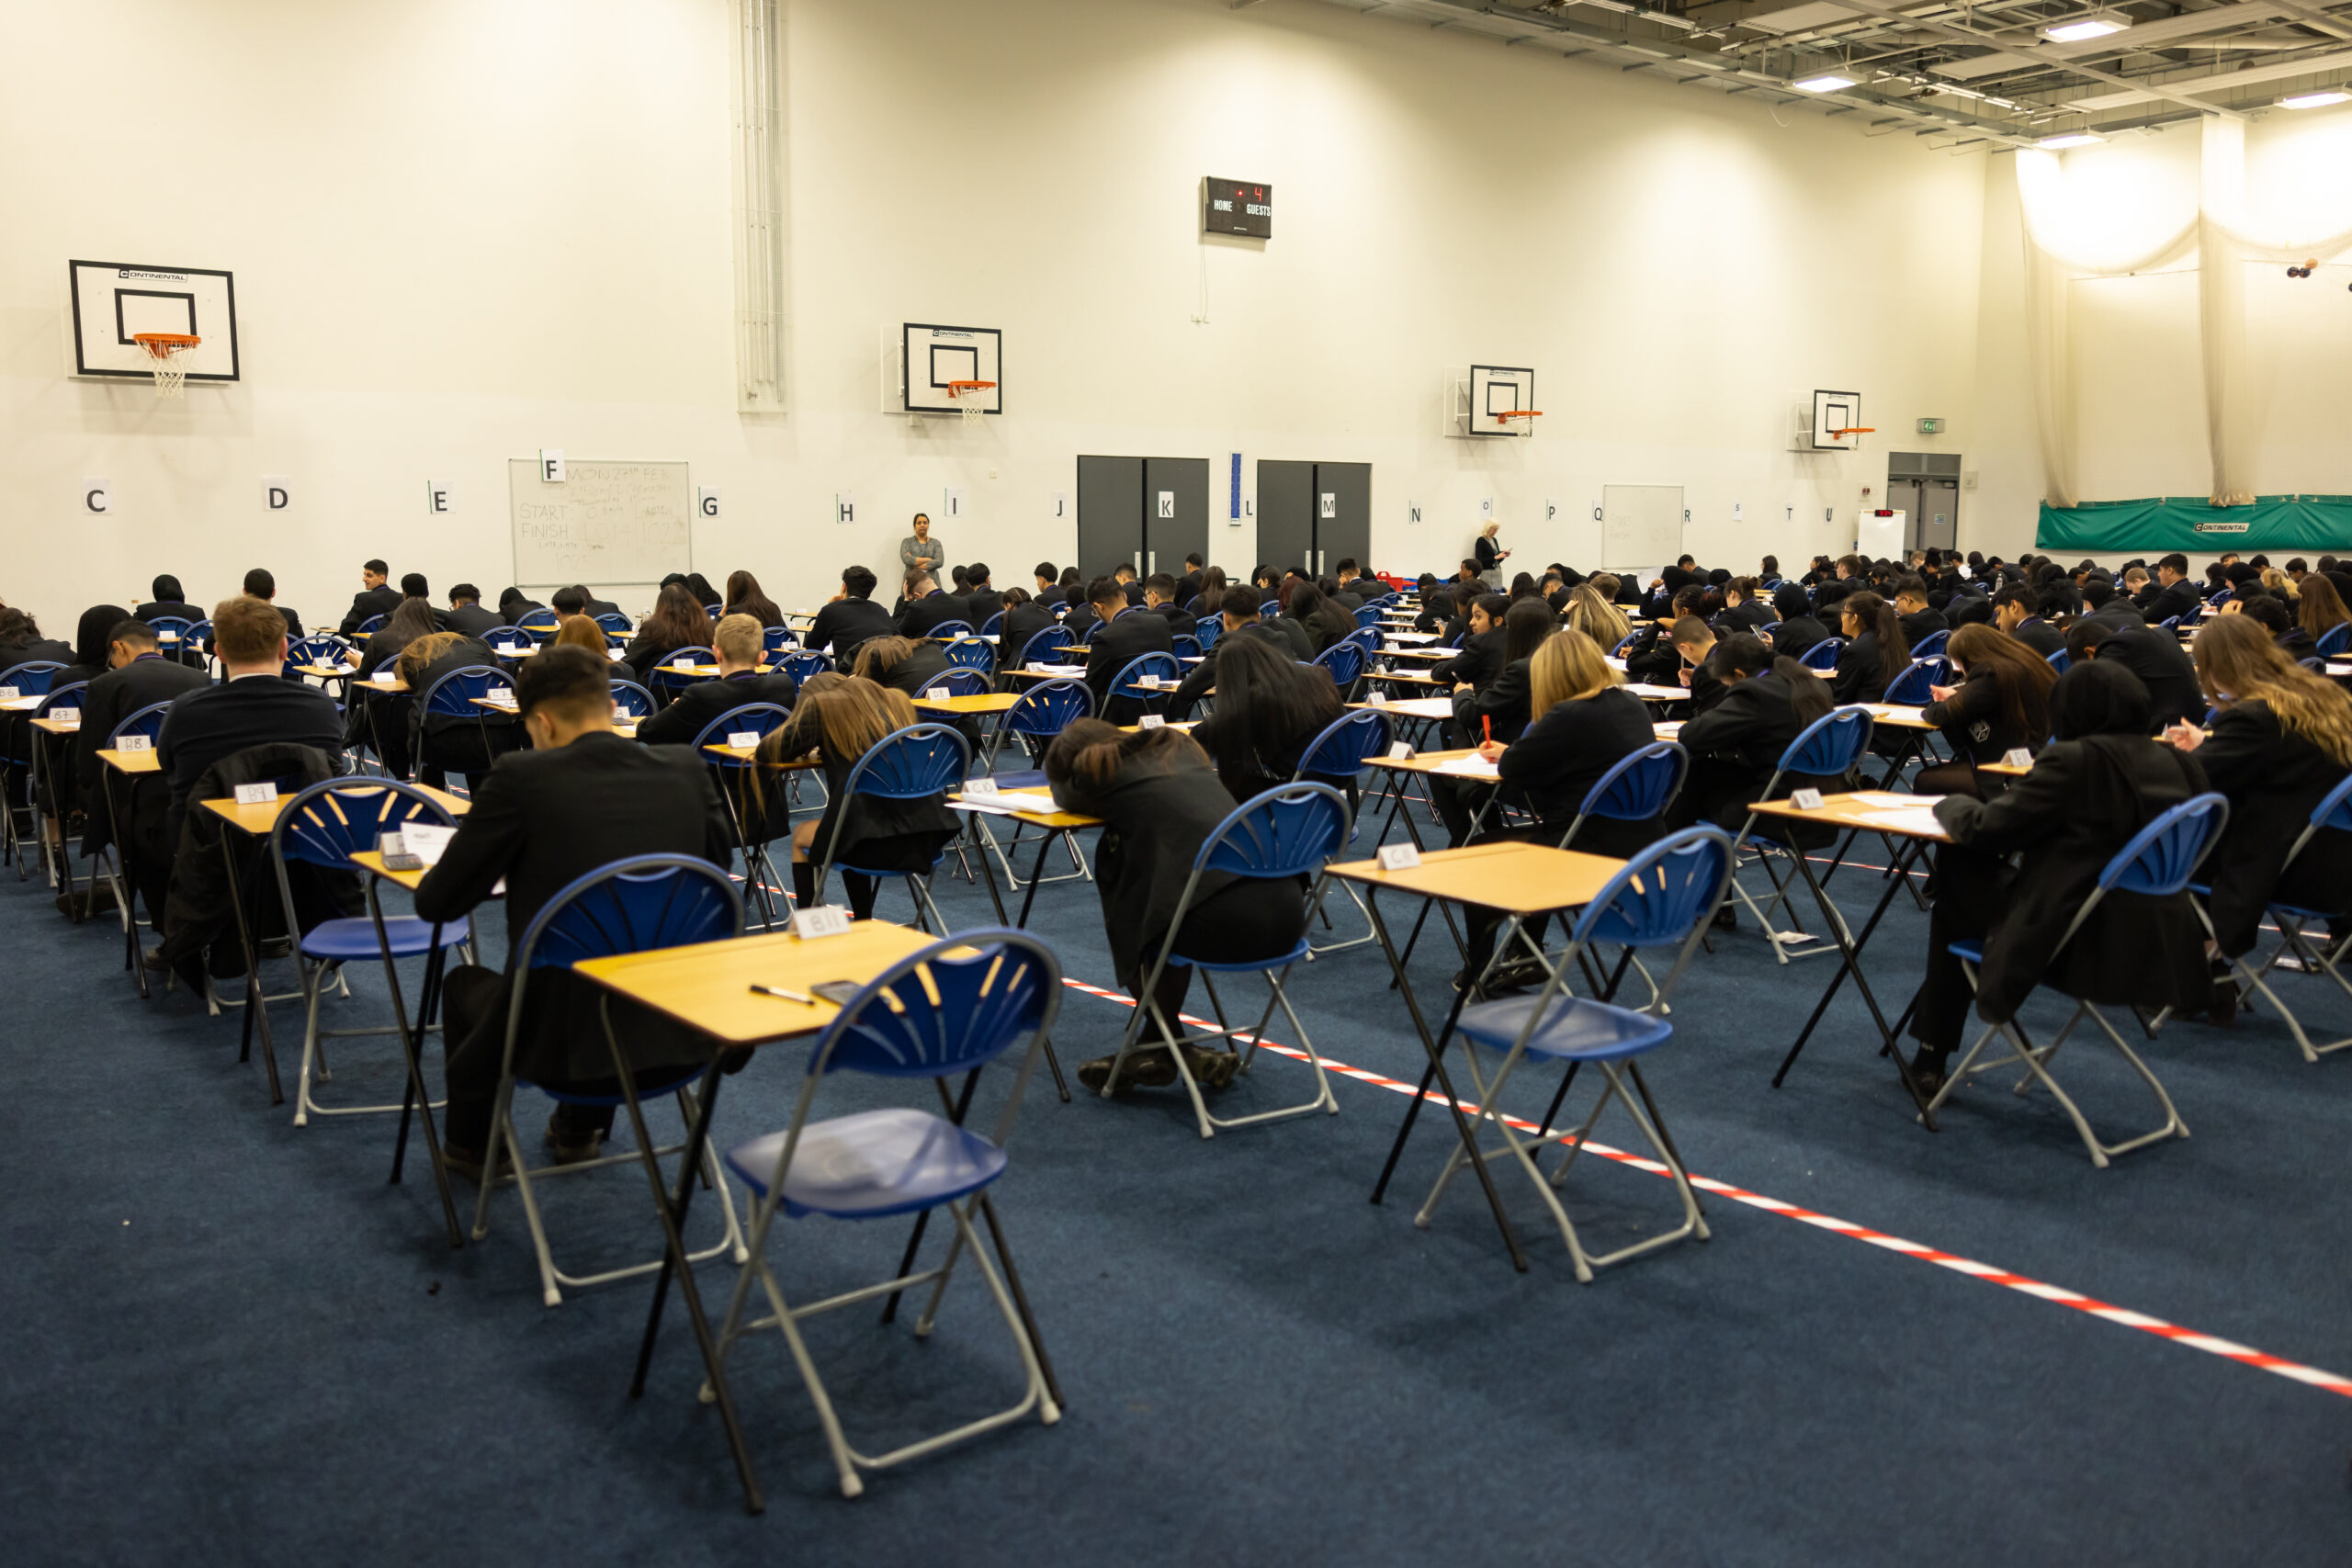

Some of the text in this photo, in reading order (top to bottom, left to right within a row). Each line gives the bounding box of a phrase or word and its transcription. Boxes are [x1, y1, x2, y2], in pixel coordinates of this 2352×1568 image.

[1254, 186, 1262, 202] 4
[1214, 199, 1271, 217] HOME GUESTS
[119, 269, 187, 281] CONTINENTAL
[546, 460, 558, 479] F
[566, 468, 610, 481] MON
[86, 489, 106, 513] C
[268, 487, 288, 509] D
[434, 491, 447, 512] E
[702, 496, 718, 516] G
[953, 497, 957, 515] I
[840, 503, 854, 522] H
[1056, 500, 1063, 517] J
[1161, 500, 1171, 516] K
[1246, 500, 1253, 516] L
[1323, 500, 1334, 513] M
[1483, 502, 1489, 511] O
[1548, 505, 1555, 520] P
[1594, 507, 1603, 522] Q
[1735, 503, 1740, 512] S
[1786, 507, 1793, 520] T
[1411, 507, 1420, 523] N
[1684, 509, 1690, 523] R
[1826, 507, 1833, 523] U
[2194, 523, 2247, 532] CONTINENTAL
[932, 690, 944, 698] D8
[125, 738, 142, 751] B8
[246, 786, 266, 802] B9
[808, 910, 842, 932] B11
